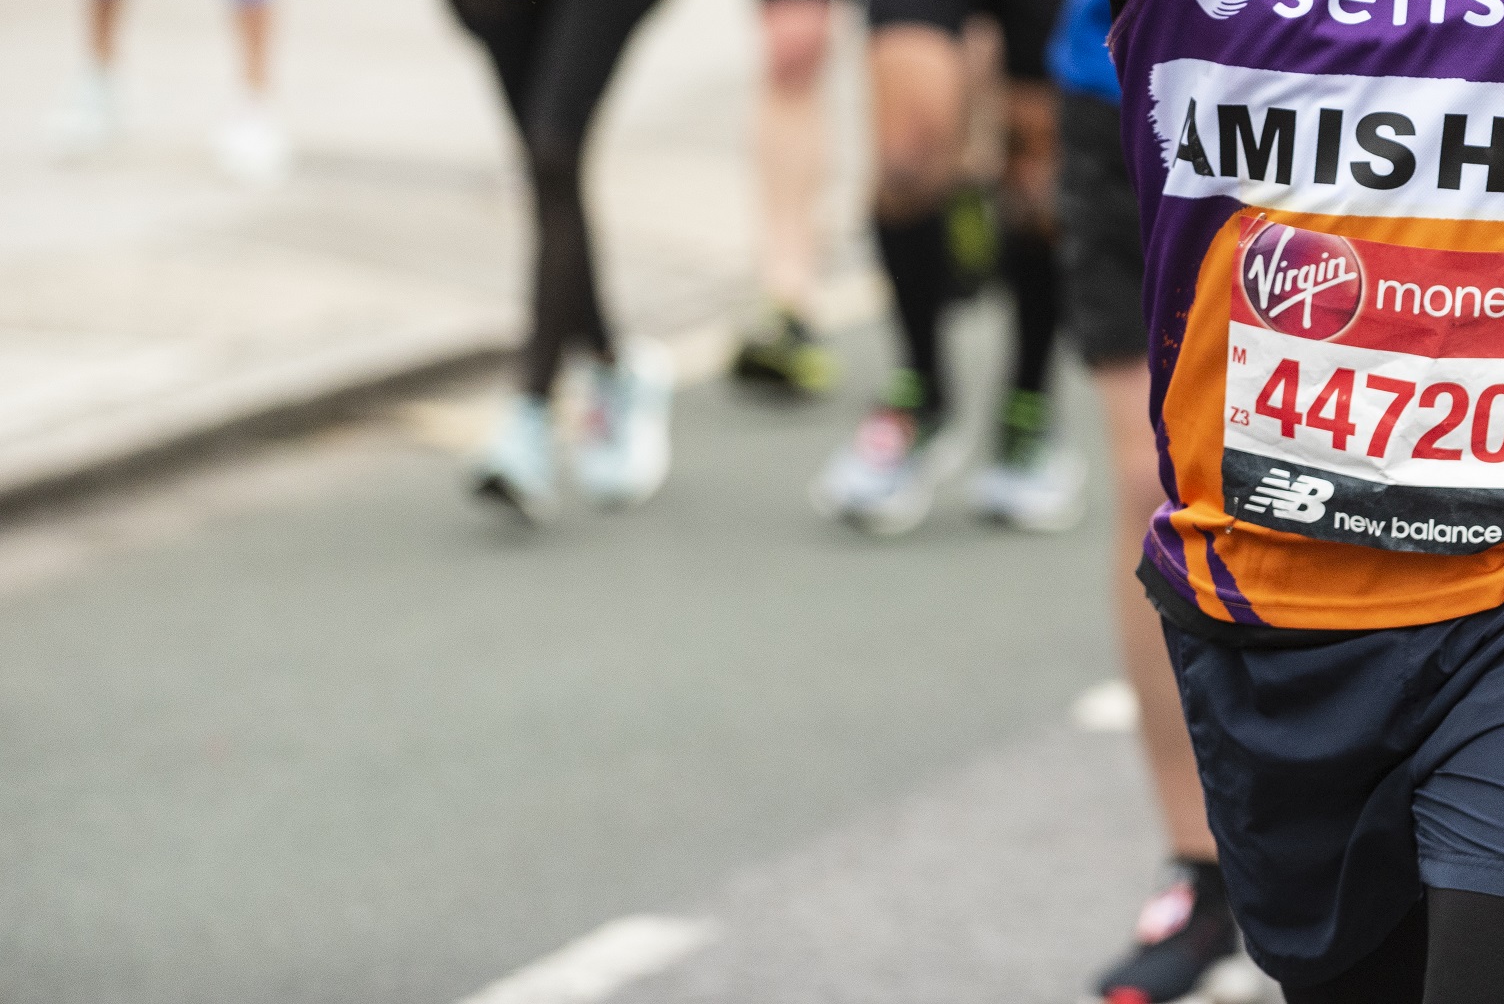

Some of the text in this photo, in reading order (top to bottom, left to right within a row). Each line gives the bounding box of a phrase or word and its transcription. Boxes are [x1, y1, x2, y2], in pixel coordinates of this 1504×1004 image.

[1248, 226, 1358, 329] Virgin
[1231, 345, 1247, 365] M
[1230, 406, 1250, 426] Z3
[1334, 510, 1502, 544] new balance
